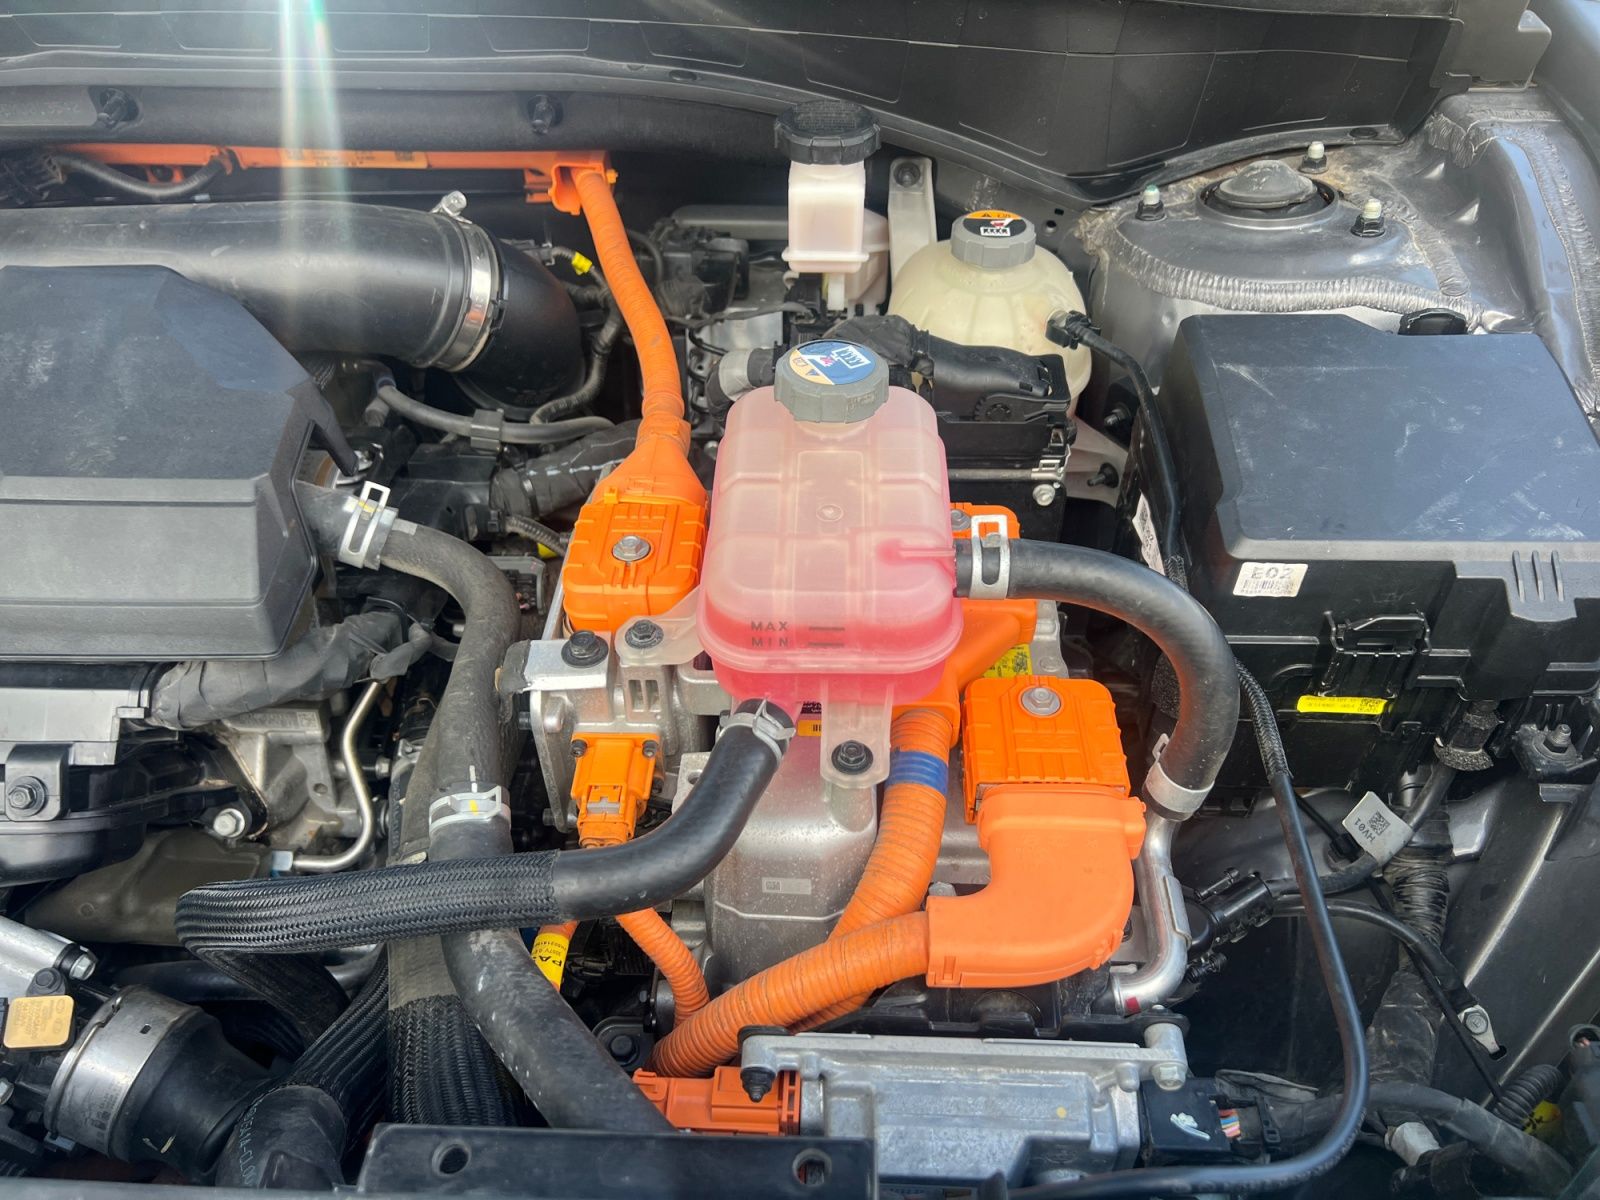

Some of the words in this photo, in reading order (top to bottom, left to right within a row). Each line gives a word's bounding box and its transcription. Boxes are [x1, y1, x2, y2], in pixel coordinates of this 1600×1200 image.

[1250, 566, 1294, 580] E02
[751, 622, 788, 632] MAX
[751, 637, 788, 648] MIN
